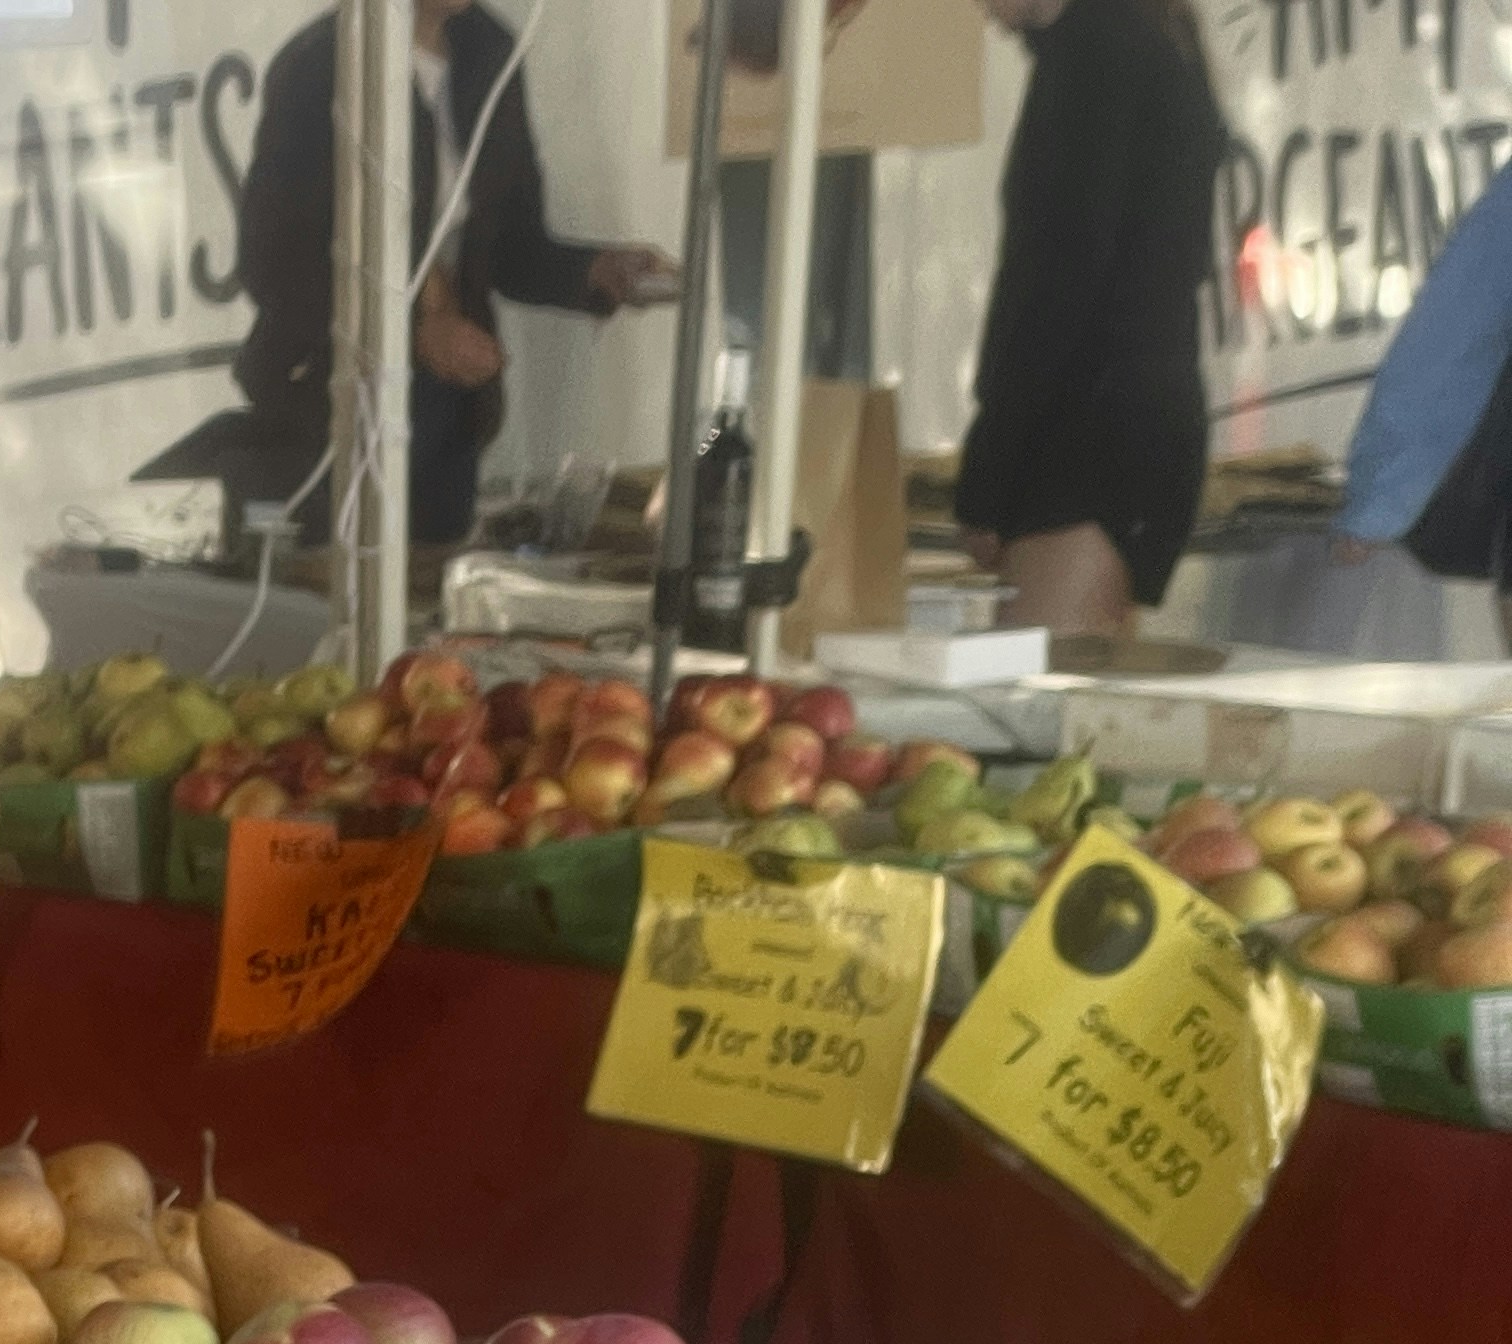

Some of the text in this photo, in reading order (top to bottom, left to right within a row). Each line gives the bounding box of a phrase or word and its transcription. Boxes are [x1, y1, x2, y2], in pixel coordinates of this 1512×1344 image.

[672, 1004, 708, 1061] 7
[1003, 1007, 1042, 1065] 7
[1043, 1053, 1109, 1113] for
[1079, 1002, 1165, 1081] Sweet
[1174, 1003, 1238, 1074] Fuji
